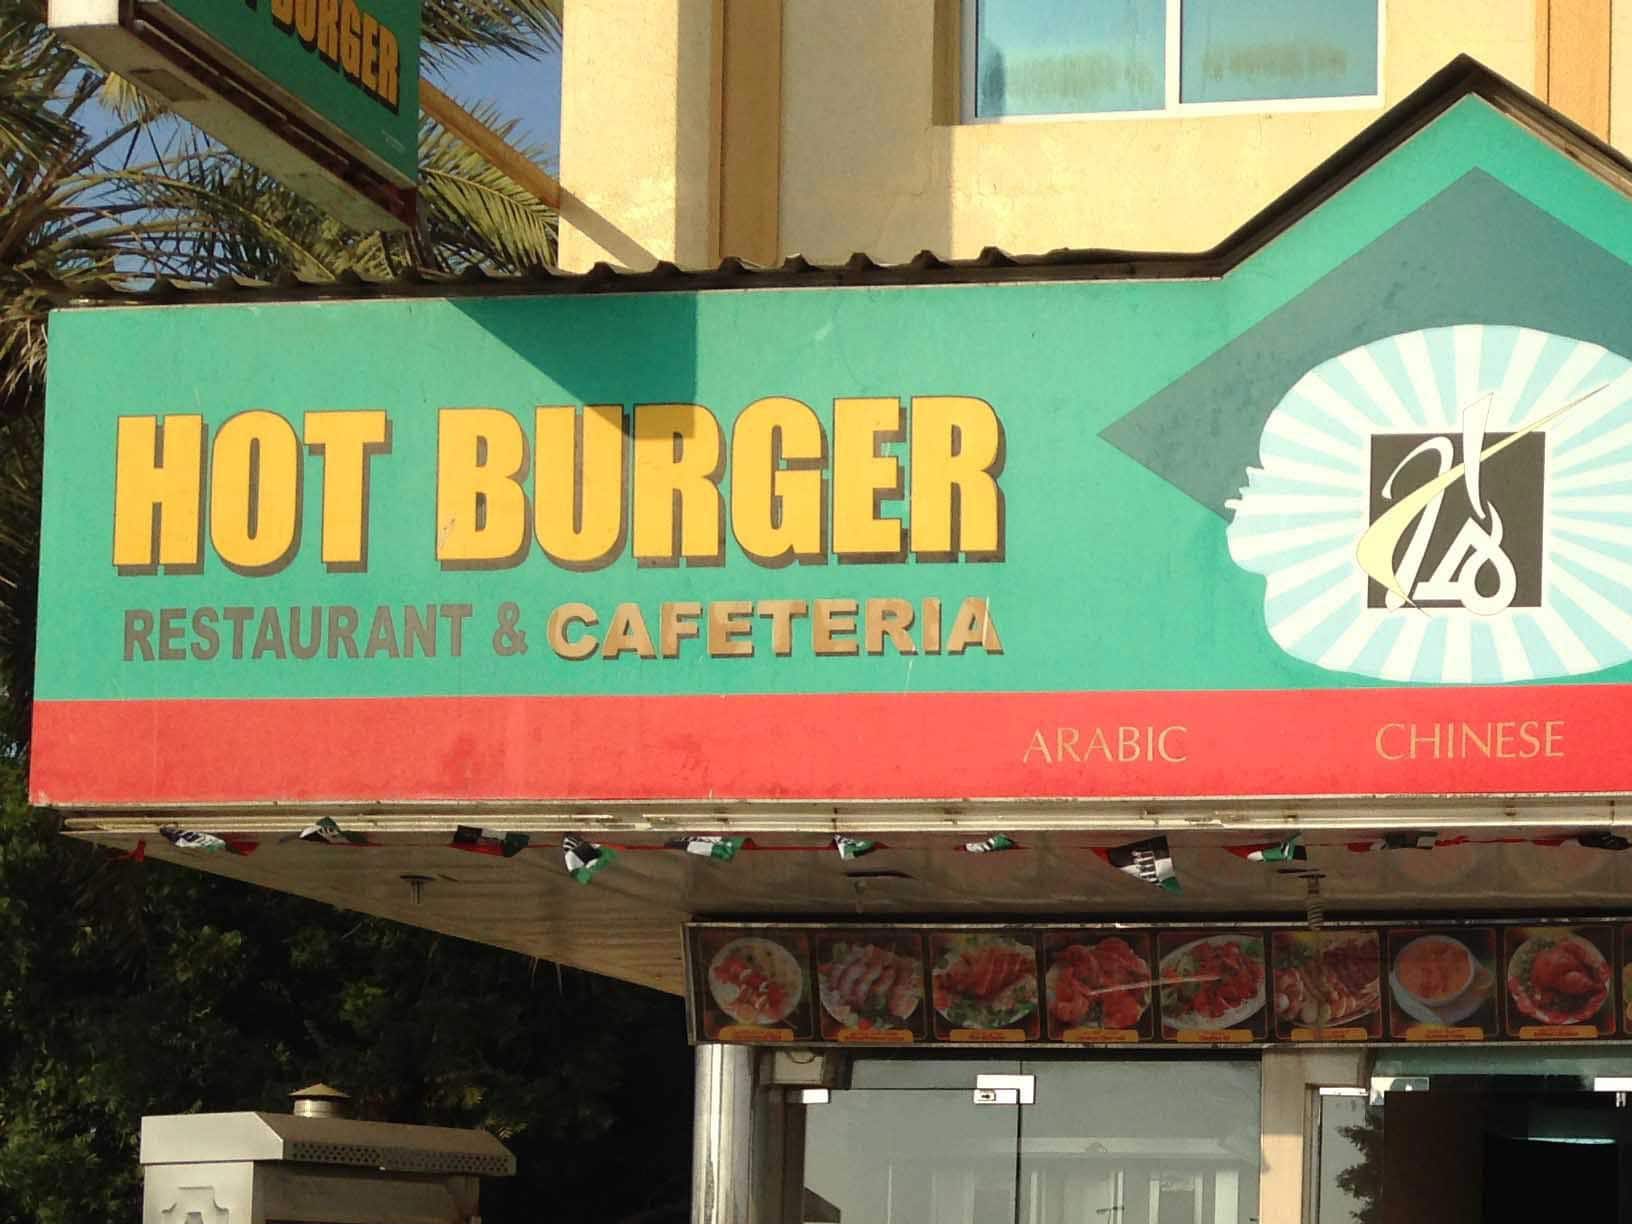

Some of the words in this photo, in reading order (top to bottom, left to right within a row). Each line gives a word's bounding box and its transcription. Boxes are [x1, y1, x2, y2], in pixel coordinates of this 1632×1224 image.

[112, 408, 393, 576] HOT
[435, 395, 1005, 572] BURGER
[122, 602, 473, 664] RESTAURANT
[495, 600, 528, 657] &
[545, 596, 1005, 661] CAFETERIA
[1022, 725, 1189, 764] ARABIC
[1374, 719, 1566, 761] CHINESE
